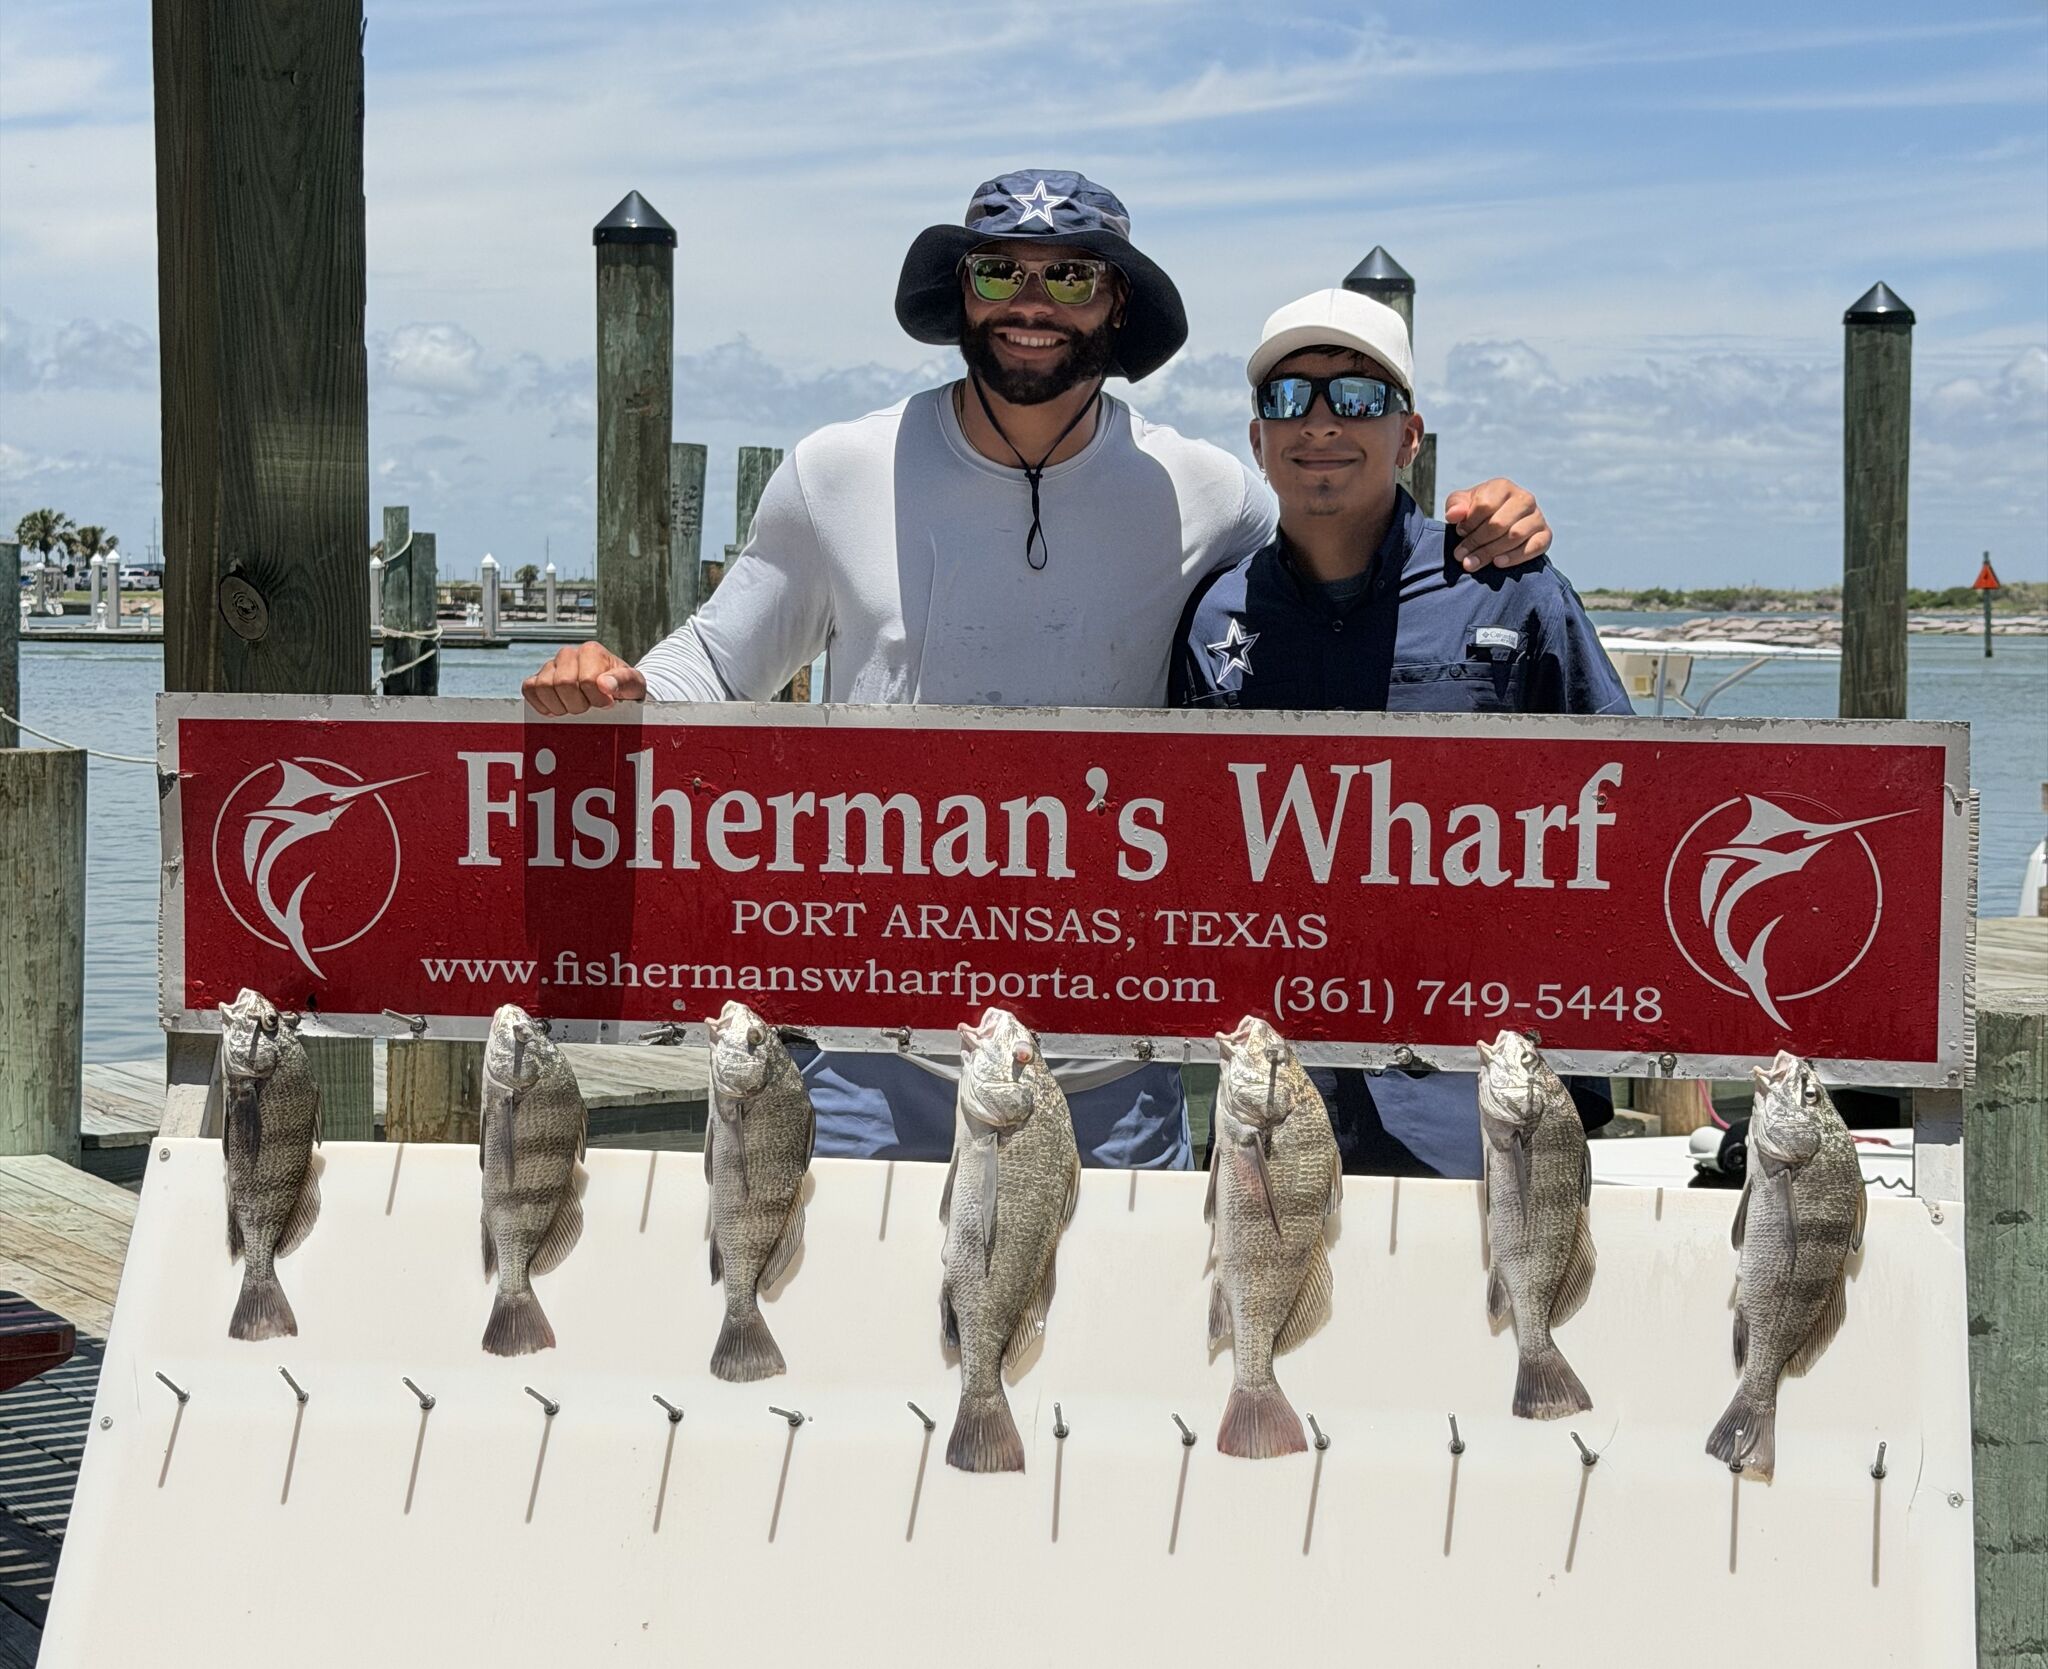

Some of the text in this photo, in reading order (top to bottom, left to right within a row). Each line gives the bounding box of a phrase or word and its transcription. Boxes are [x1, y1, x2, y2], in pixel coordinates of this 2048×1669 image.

[456, 747, 1624, 890] Fisherman's Wharf
[732, 900, 1328, 952] PORT ARANSAS, TEXAS
[420, 950, 1663, 1025] www.fishermanswharfporta.com (361) 749-5448
